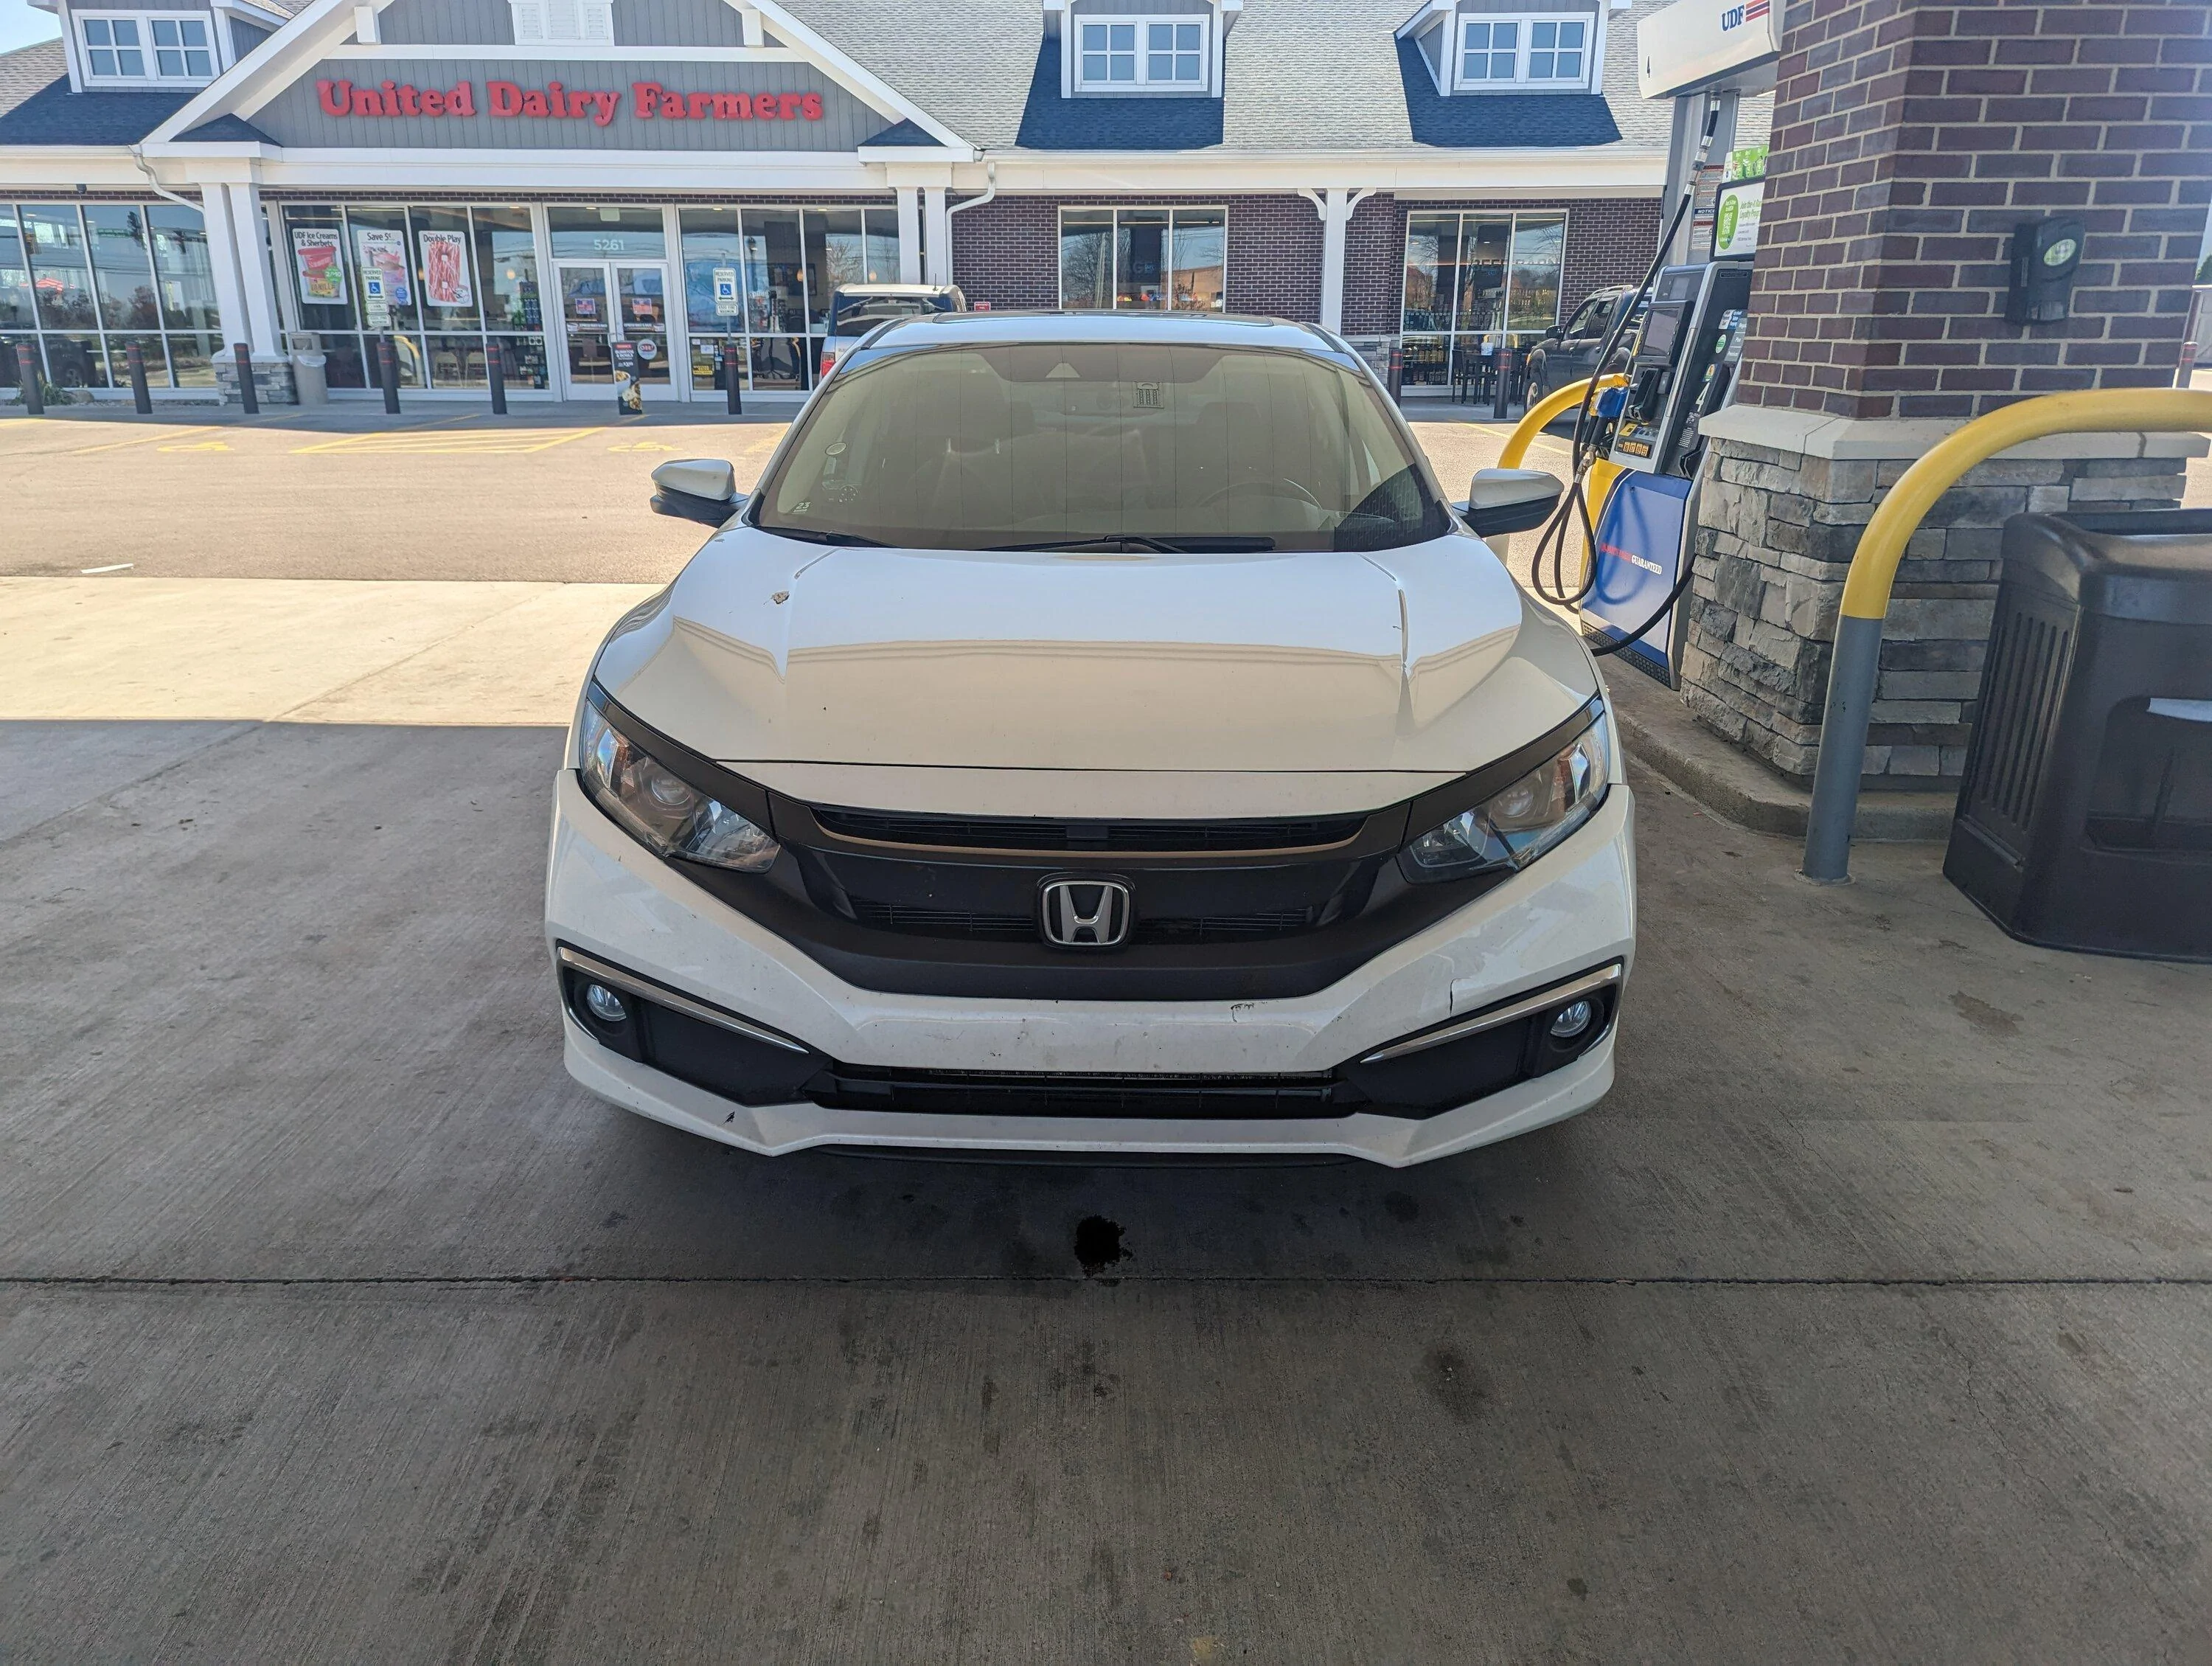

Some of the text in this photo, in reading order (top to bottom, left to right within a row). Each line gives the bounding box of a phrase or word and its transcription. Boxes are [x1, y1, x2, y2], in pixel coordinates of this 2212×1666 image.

[1722, 4, 1745, 31] UDF
[316, 80, 824, 126] United Dairy Farmers
[307, 239, 333, 248] Sherbets
[367, 232, 383, 240] Save
[423, 234, 462, 244] Double Play
[593, 239, 625, 251] 5261
[1695, 382, 1711, 412] 4
[1631, 555, 1662, 575] GUARANTEED
